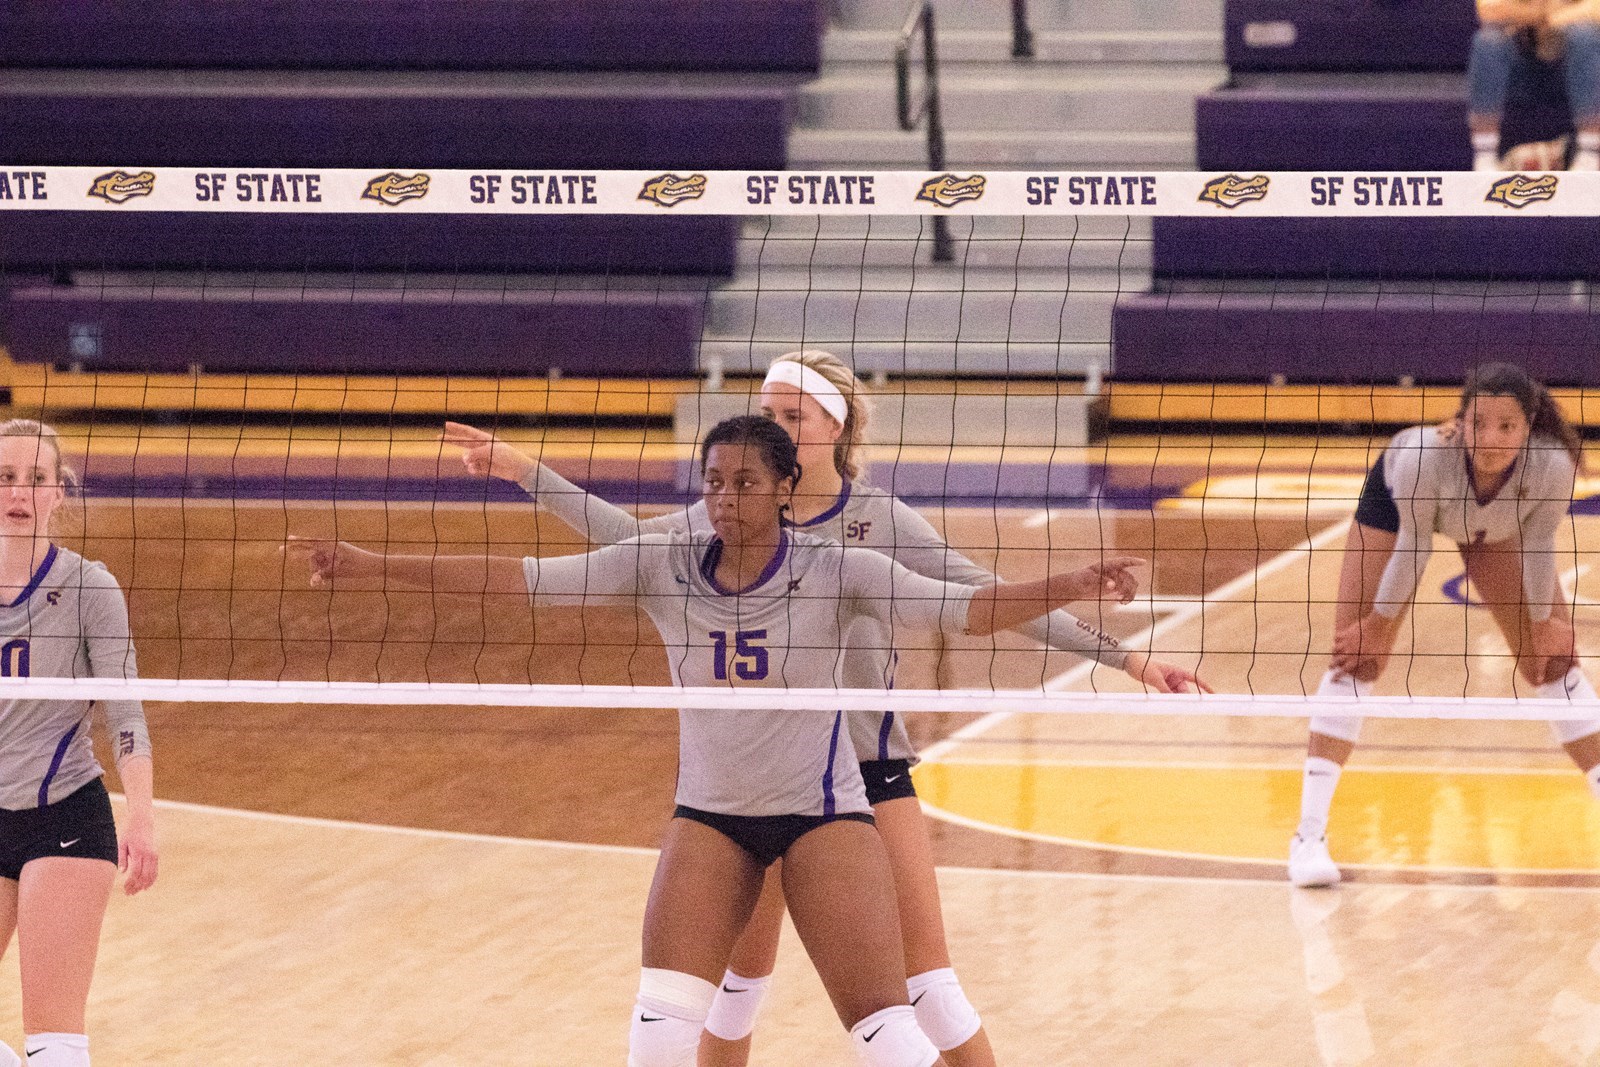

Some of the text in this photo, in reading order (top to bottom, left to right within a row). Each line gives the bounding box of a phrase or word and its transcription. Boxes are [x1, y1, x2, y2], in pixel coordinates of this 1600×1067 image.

[194, 173, 322, 203] SF STATE
[469, 175, 598, 205] SF STATE
[746, 175, 875, 205] SF STATE
[1026, 176, 1156, 206] SF STATE
[1310, 176, 1443, 206] SF STATE
[846, 520, 871, 541] SF
[708, 628, 769, 681] 15
